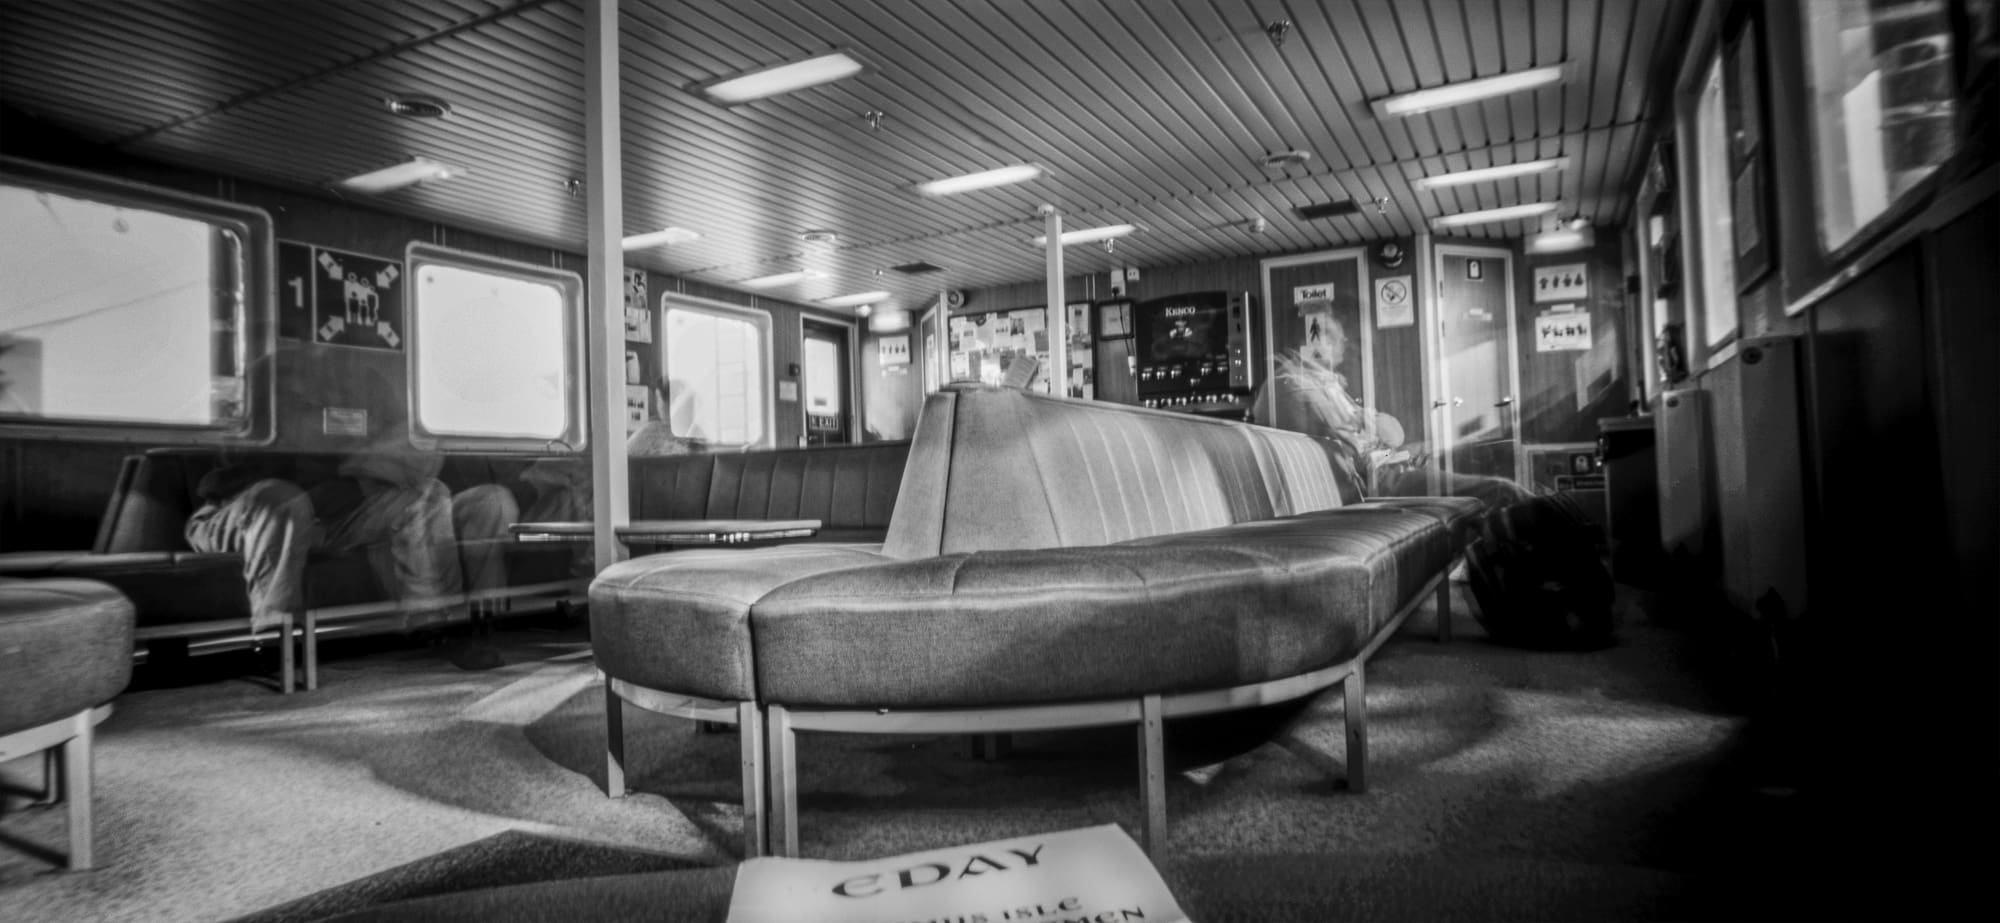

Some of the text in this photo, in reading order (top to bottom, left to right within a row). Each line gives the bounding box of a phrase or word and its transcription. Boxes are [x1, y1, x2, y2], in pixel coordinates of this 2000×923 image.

[287, 276, 304, 308] 1
[1300, 288, 1327, 299] Toilet
[831, 844, 1045, 899] EDAY
